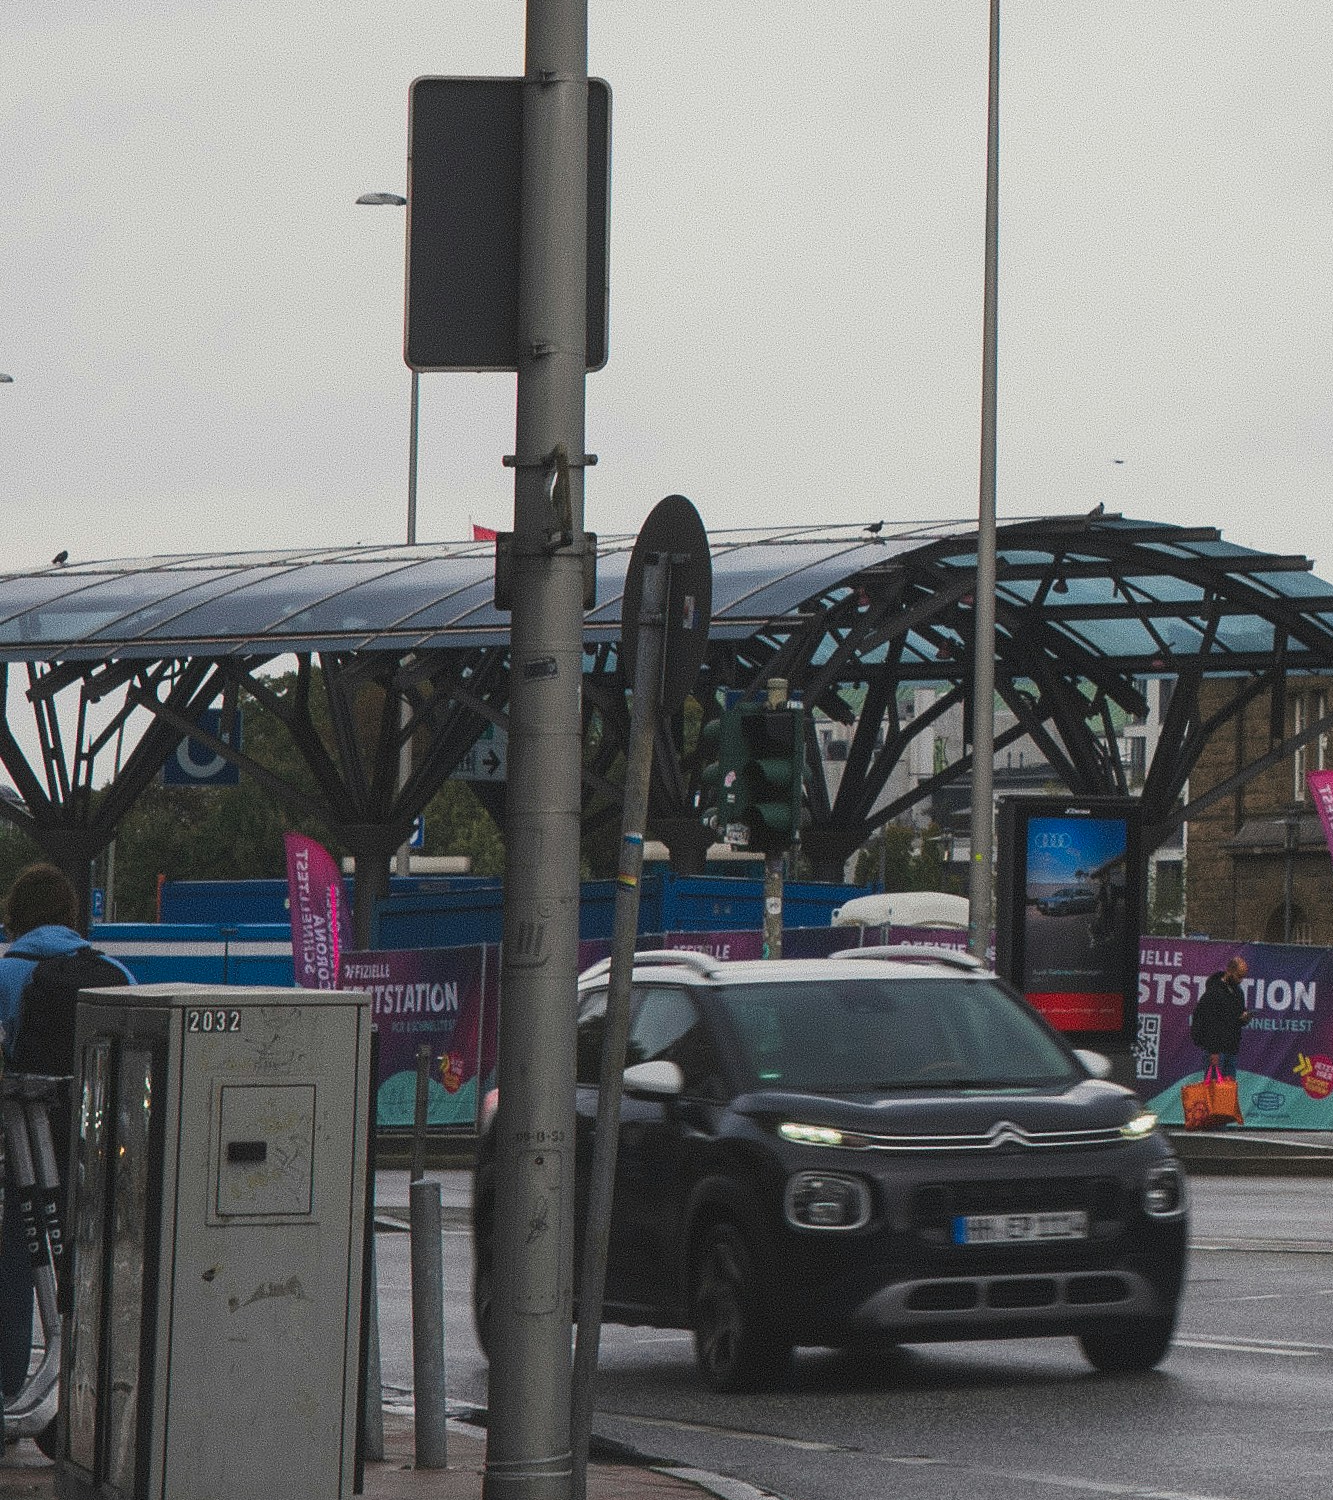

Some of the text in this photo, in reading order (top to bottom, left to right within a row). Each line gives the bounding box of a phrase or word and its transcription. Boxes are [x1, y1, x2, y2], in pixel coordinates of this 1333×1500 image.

[189, 1010, 241, 1032] 2032
[20, 1199, 40, 1254] BIRD
[44, 1201, 64, 1255] BIRD
